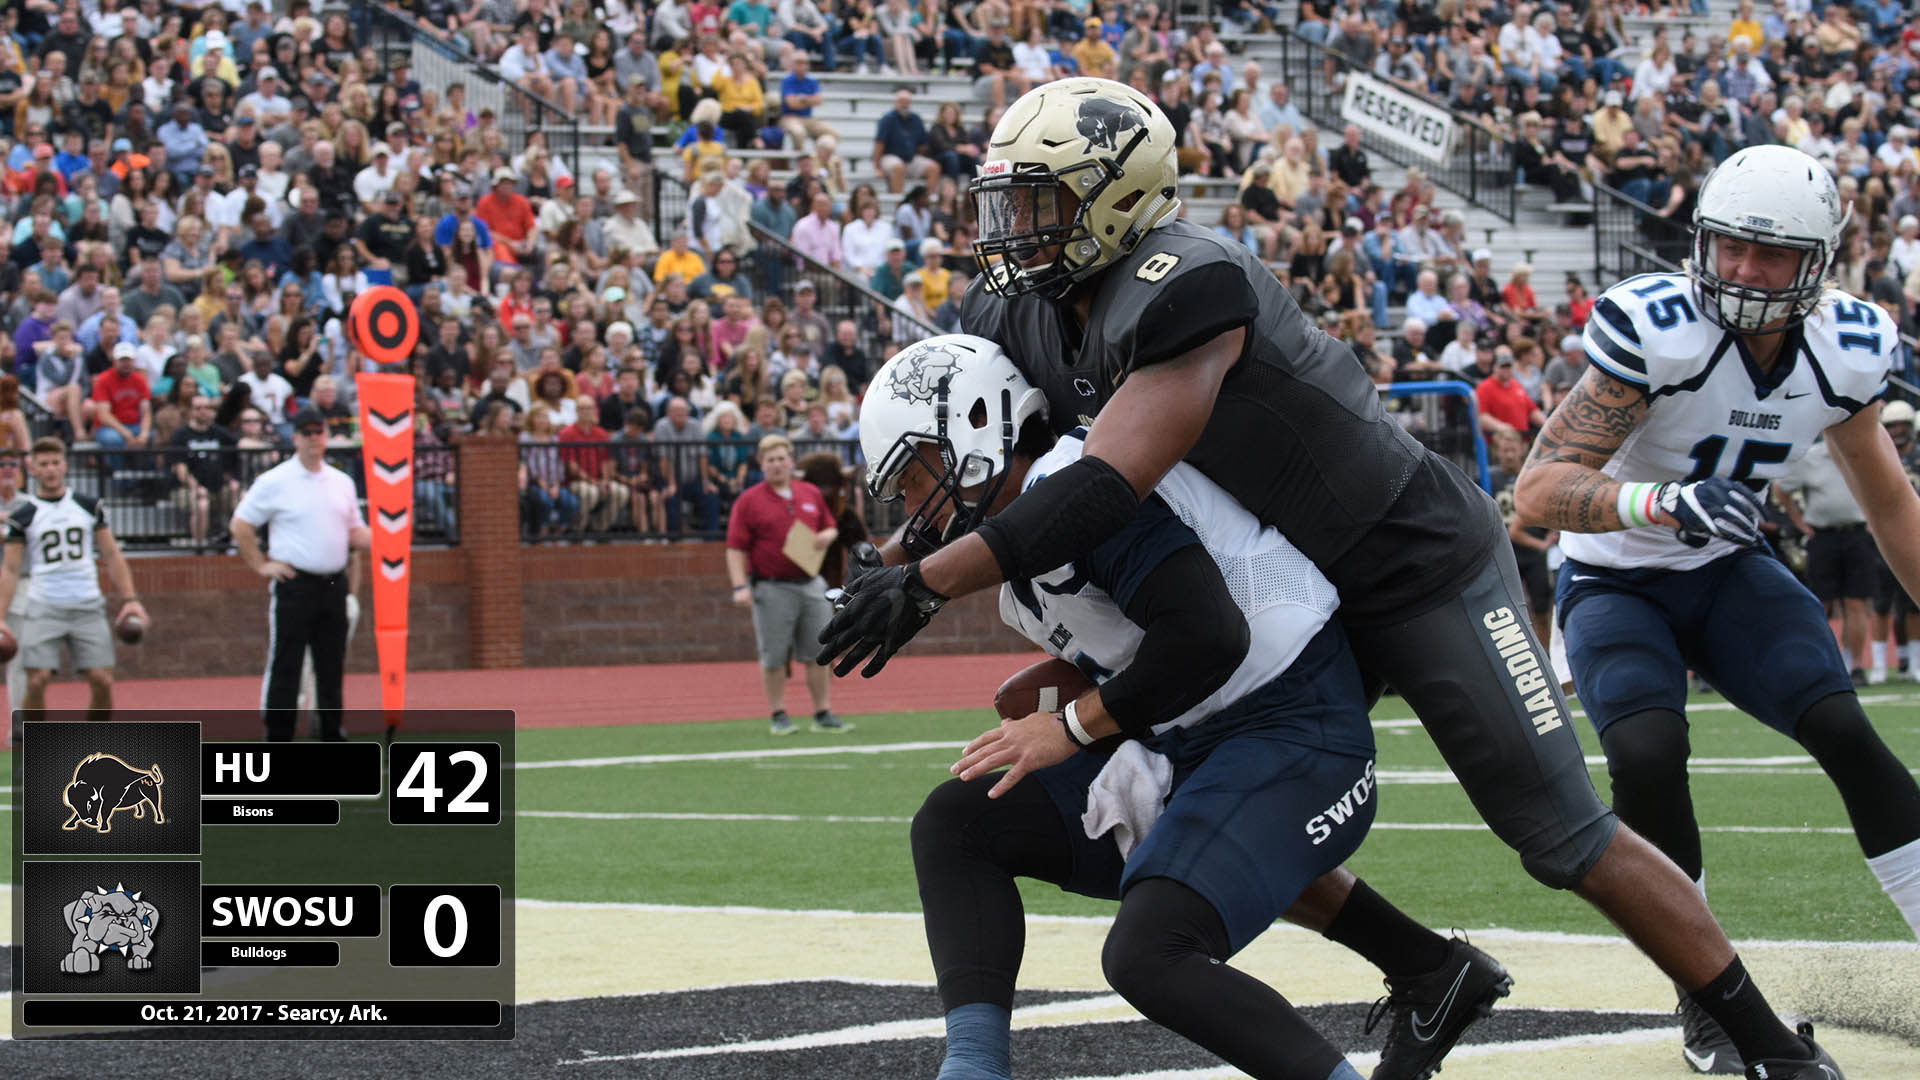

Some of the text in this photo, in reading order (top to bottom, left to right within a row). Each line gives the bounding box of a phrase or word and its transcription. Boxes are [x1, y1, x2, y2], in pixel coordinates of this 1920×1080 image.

[1352, 84, 1444, 147] RESERVED
[1134, 251, 1182, 285] 8
[1630, 278, 1698, 332] 15
[1834, 299, 1881, 357] 15
[1728, 409, 1782, 430] BULLDOGS
[41, 527, 84, 563] 29
[1483, 606, 1563, 736] HARDING
